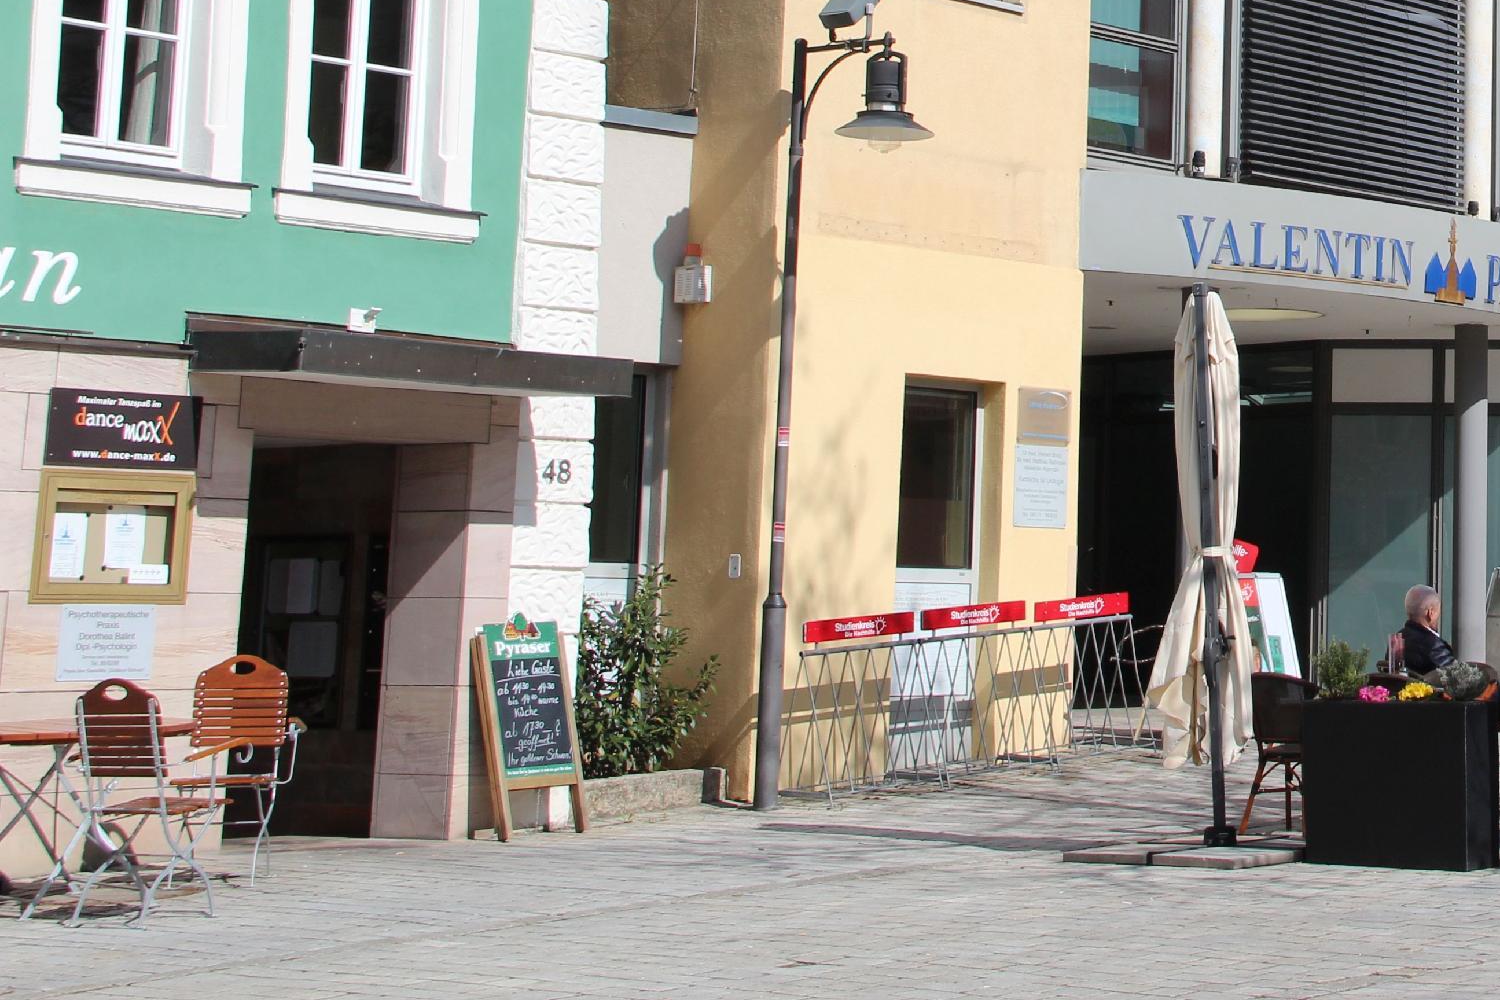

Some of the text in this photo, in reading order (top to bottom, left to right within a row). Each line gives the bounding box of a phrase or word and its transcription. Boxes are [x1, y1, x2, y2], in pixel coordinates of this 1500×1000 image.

[1176, 213, 1415, 287] VALENTIN
[77, 395, 117, 406] Maximaler
[151, 399, 162, 408] im
[73, 406, 125, 428] dance
[541, 459, 572, 485] 48
[1059, 601, 1095, 612] Studienkreis
[951, 609, 990, 620] Studienkreis
[834, 621, 875, 632] Studienkreis
[853, 629, 875, 637] Nachhilfe
[494, 641, 551, 658] Pyraser
[497, 682, 510, 696] ab
[507, 695, 519, 706] bis
[514, 705, 540, 718] Küche
[504, 721, 518, 739] ab
